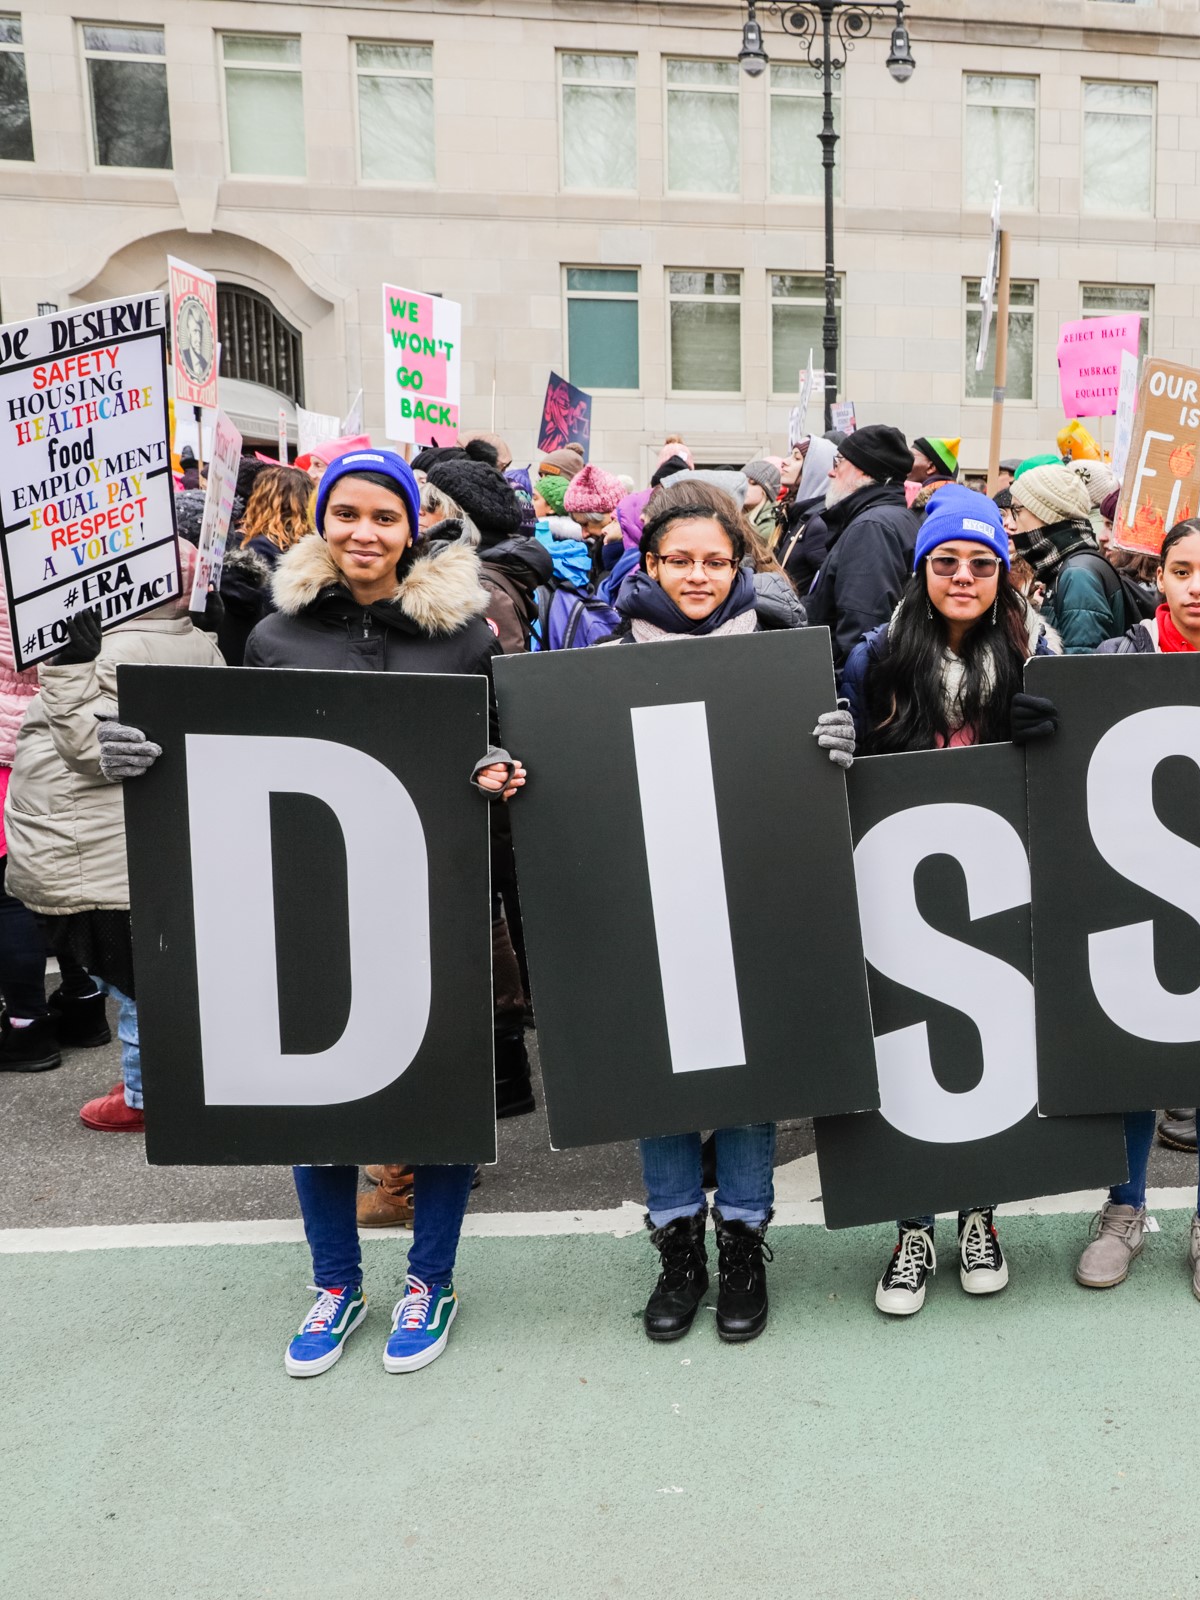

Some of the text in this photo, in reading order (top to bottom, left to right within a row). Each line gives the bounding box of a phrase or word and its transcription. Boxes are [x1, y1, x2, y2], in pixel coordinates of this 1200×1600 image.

[172, 270, 214, 312] NOT MY
[390, 296, 419, 323] WE
[48, 297, 162, 354] DESERVE
[391, 327, 454, 361] WON'T
[1063, 327, 1127, 344] REJECT HATE
[33, 346, 119, 390] SAFETY
[397, 366, 423, 390] GO
[1079, 365, 1117, 377] EMBRACE
[1149, 371, 1198, 403] OUR
[7, 370, 123, 422] HOUSING
[400, 398, 457, 428] BACK.
[1075, 386, 1119, 399] EQUALITY
[15, 386, 153, 446] HEALTHCARE
[1179, 406, 1200, 428] IS
[48, 428, 95, 472] food
[11, 440, 166, 511] EMPLOYMENT
[30, 472, 144, 531] EQUAL PAY
[51, 497, 147, 550] RESPECT
[43, 556, 58, 580] A
[64, 562, 133, 609] #ERA
[22, 587, 135, 655] #EQITY
[137, 571, 175, 606] ACT
